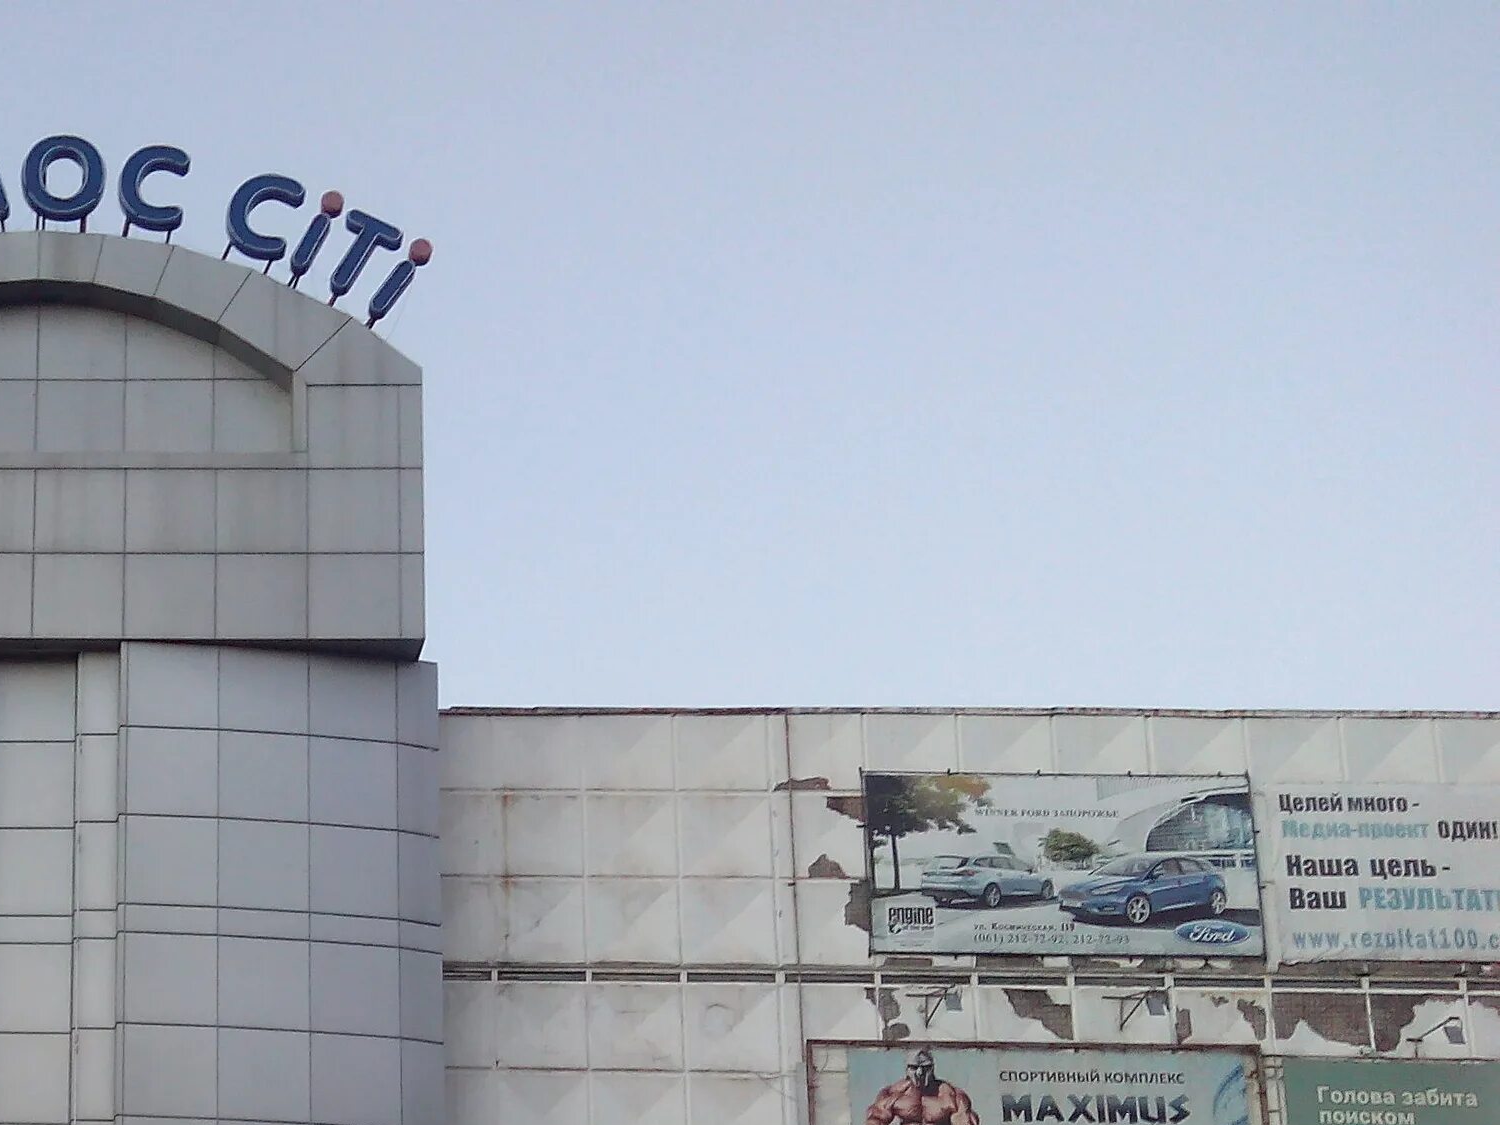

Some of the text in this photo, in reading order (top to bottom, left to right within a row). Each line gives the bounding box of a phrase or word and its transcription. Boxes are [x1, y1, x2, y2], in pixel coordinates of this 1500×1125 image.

[1278, 792, 1343, 815] Целей
[1347, 796, 1408, 813] много
[1281, 819, 1430, 841] Медиа-проект
[1286, 854, 1359, 877] Наша
[1370, 858, 1437, 880] цель
[1289, 887, 1347, 910] Ваш
[888, 906, 934, 925] engine
[1189, 925, 1237, 943] Ford
[999, 1068, 1185, 1085] СПОРТИВНЫЙ КОМПЛЕКС
[1316, 1085, 1479, 1108] Голова забита
[1001, 1093, 1191, 1125] MAXIMUS
[1319, 1110, 1417, 1125] поиском
